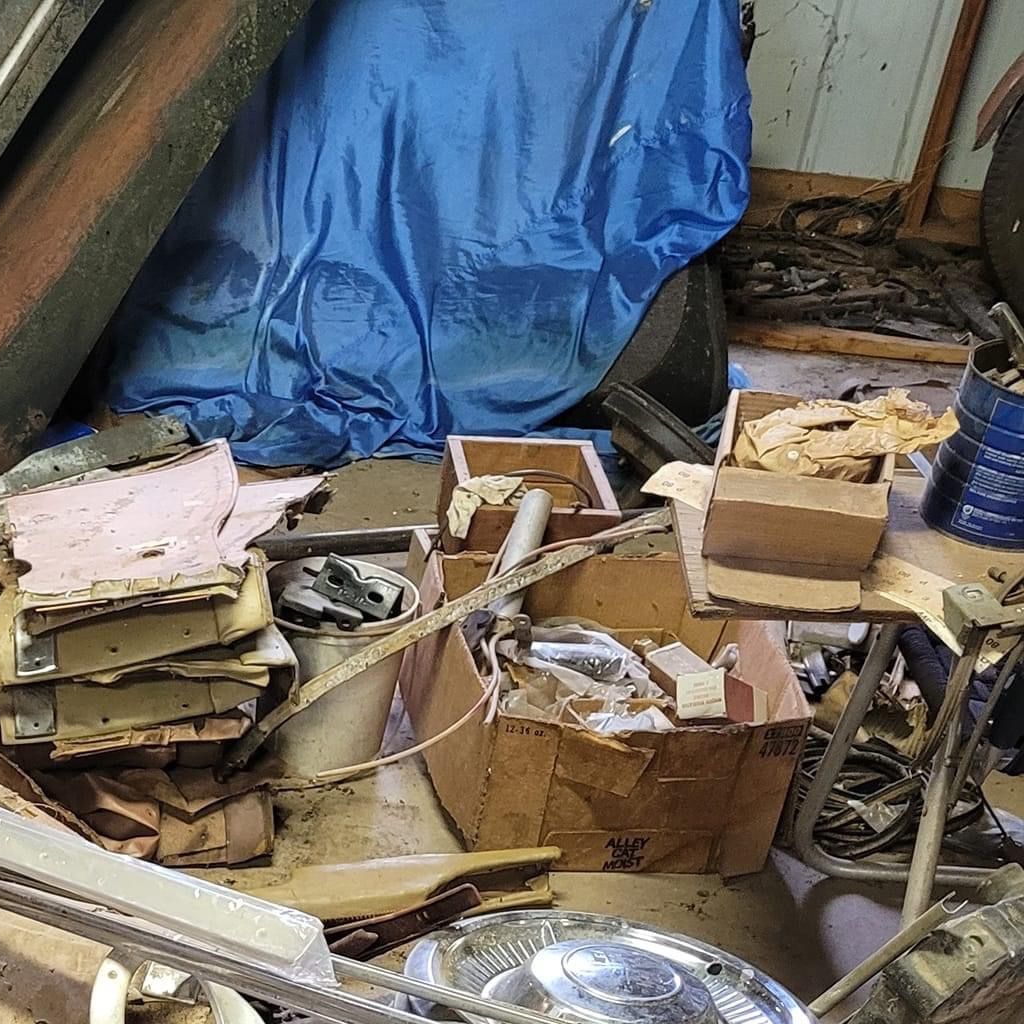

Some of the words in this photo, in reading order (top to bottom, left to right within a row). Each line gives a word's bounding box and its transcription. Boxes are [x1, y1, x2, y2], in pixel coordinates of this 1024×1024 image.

[604, 837, 651, 850] ALLEY
[611, 847, 640, 859] CAT
[602, 856, 645, 871] MOIST
